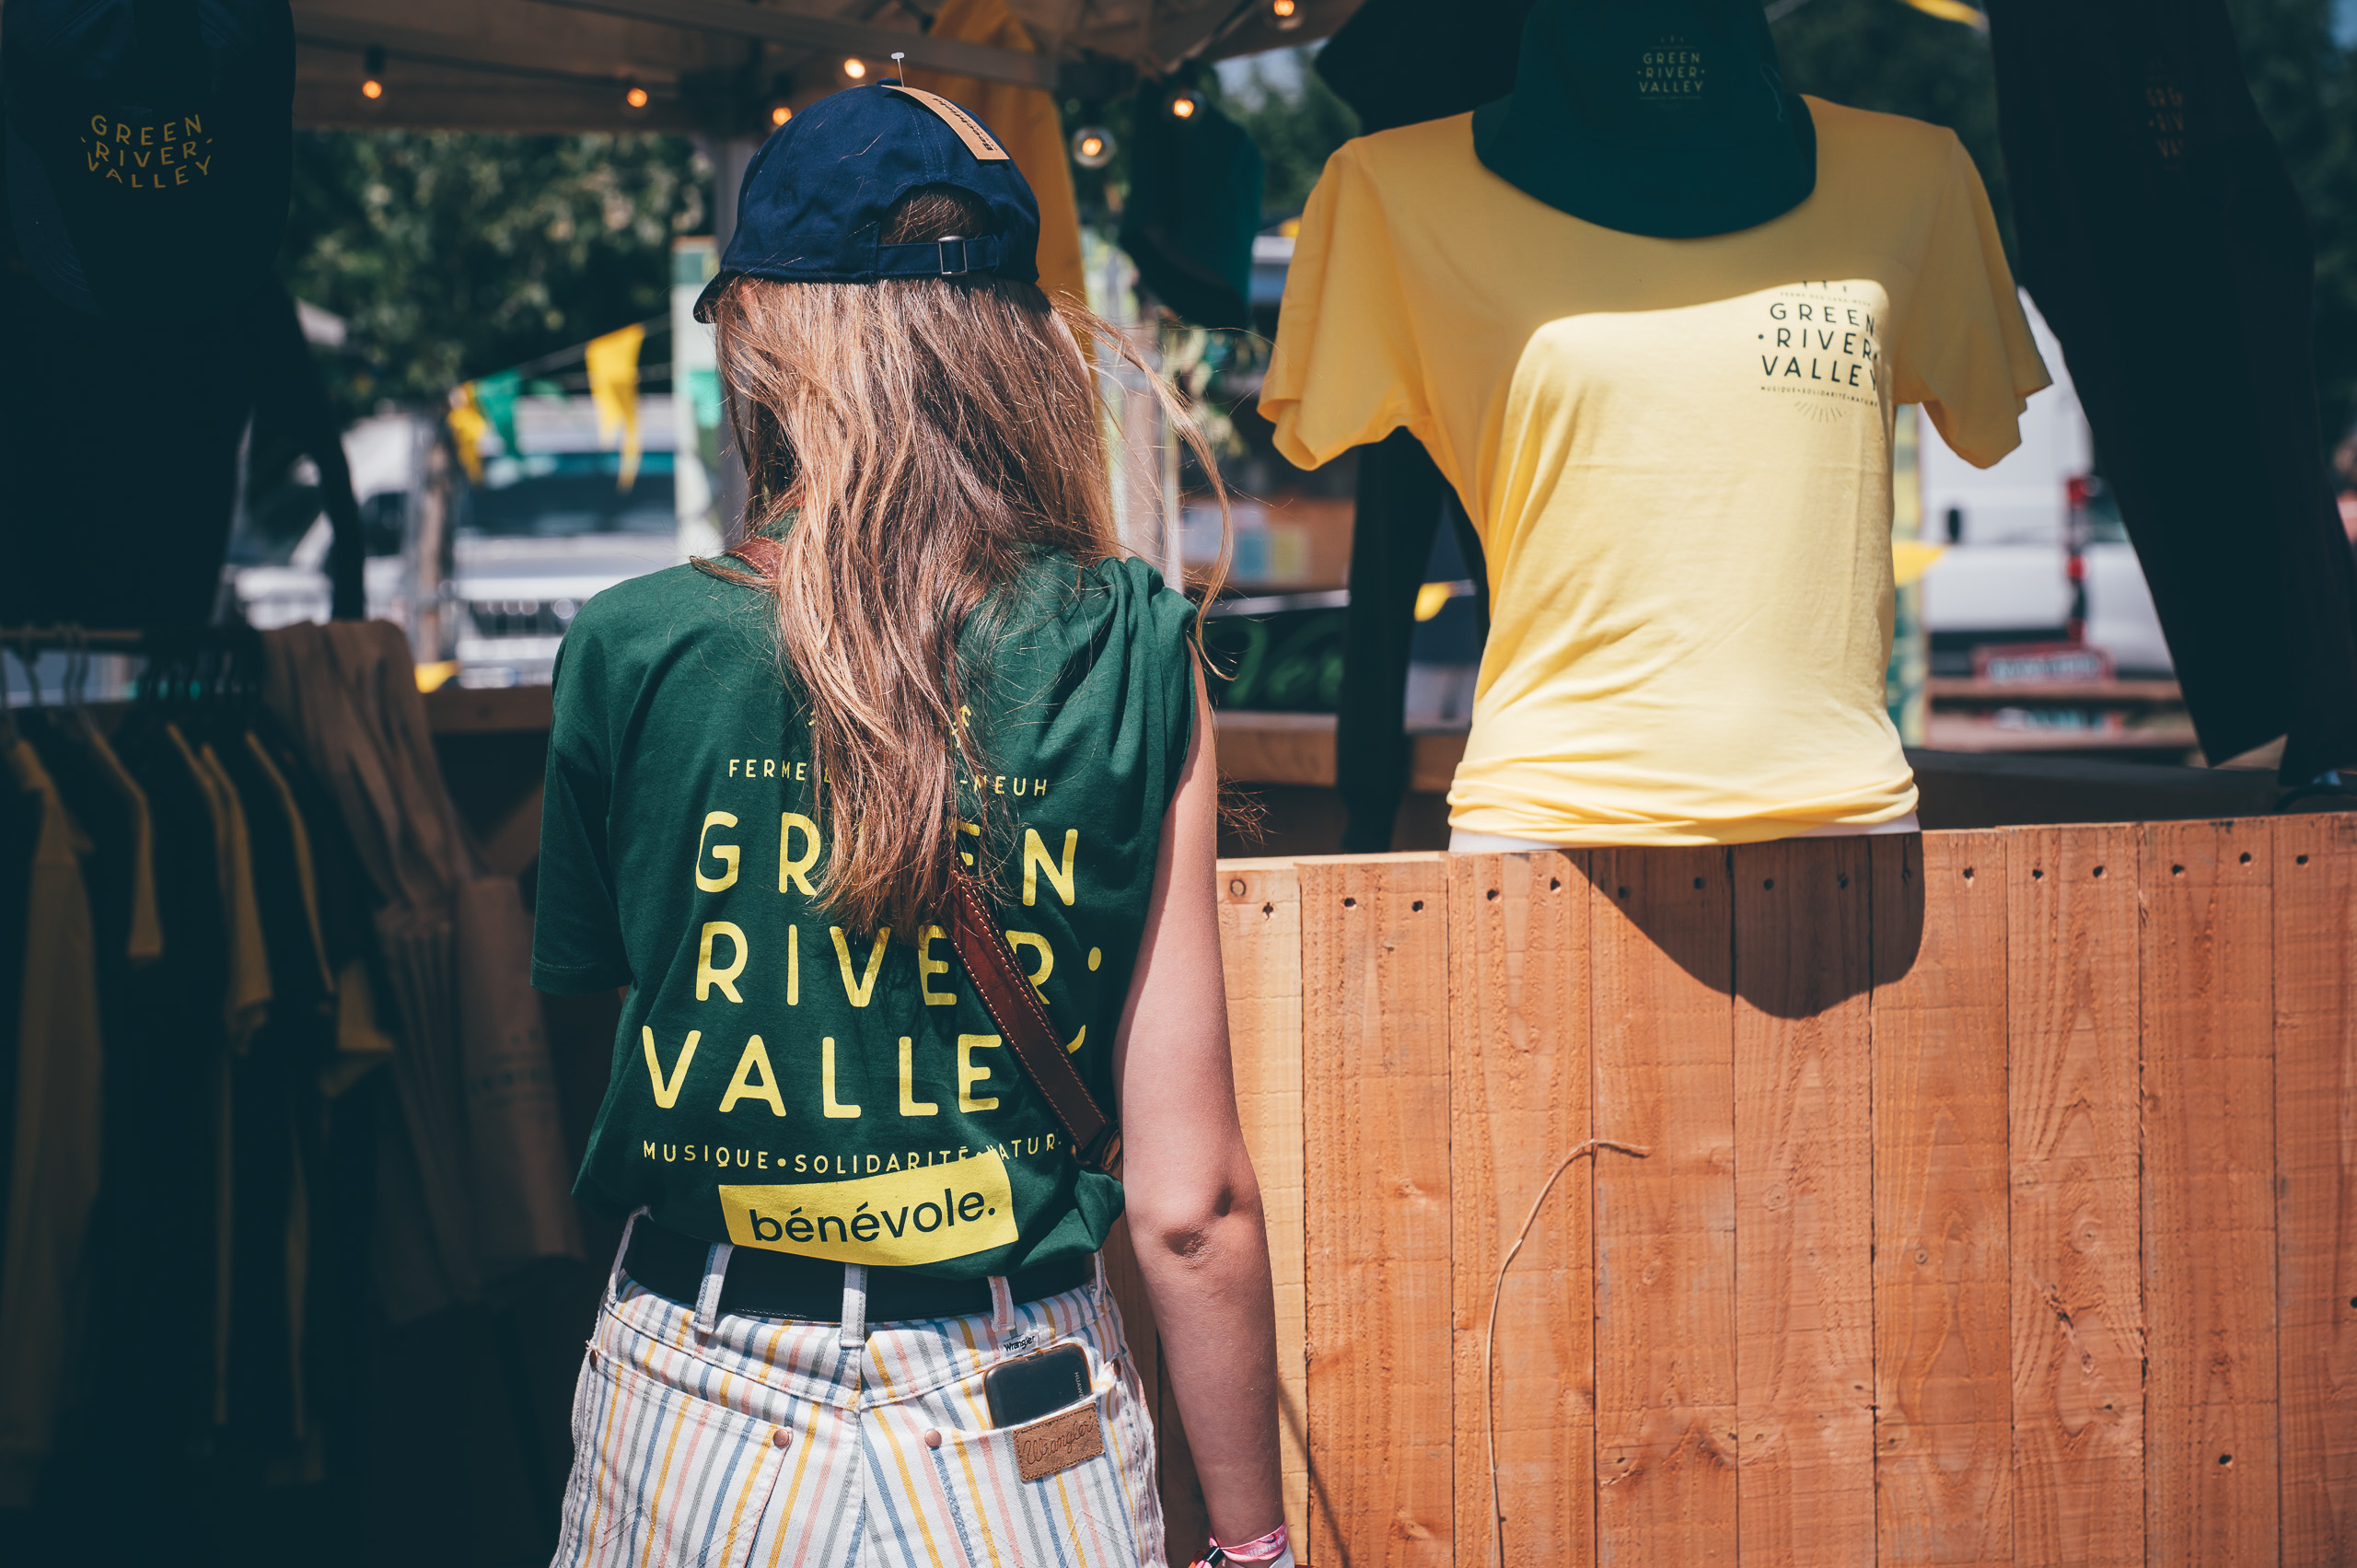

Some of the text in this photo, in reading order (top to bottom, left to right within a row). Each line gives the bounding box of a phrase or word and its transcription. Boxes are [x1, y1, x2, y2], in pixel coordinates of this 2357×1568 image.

[1642, 52, 1701, 64] GREEN
[1646, 66, 1697, 78] RIVER
[1639, 80, 1703, 93] VALLEY
[91, 114, 202, 145] GREEN
[87, 151, 211, 188] VALLEY
[96, 141, 197, 168] RIVER
[1770, 303, 1875, 337] GREEN
[1777, 328, 1872, 361] RIVER
[1761, 354, 1877, 391] VALLEY
[728, 759, 807, 782] FERME
[695, 810, 1078, 907] GRN
[642, 1025, 1086, 1119] VALLE
[986, 1128, 1061, 1160] ATUR
[749, 1188, 996, 1242] bénévole.
[1004, 1336, 1035, 1352] Wrangler
[1074, 1371, 1084, 1399] HUAWE
[1023, 1419, 1094, 1466] Wrangler
